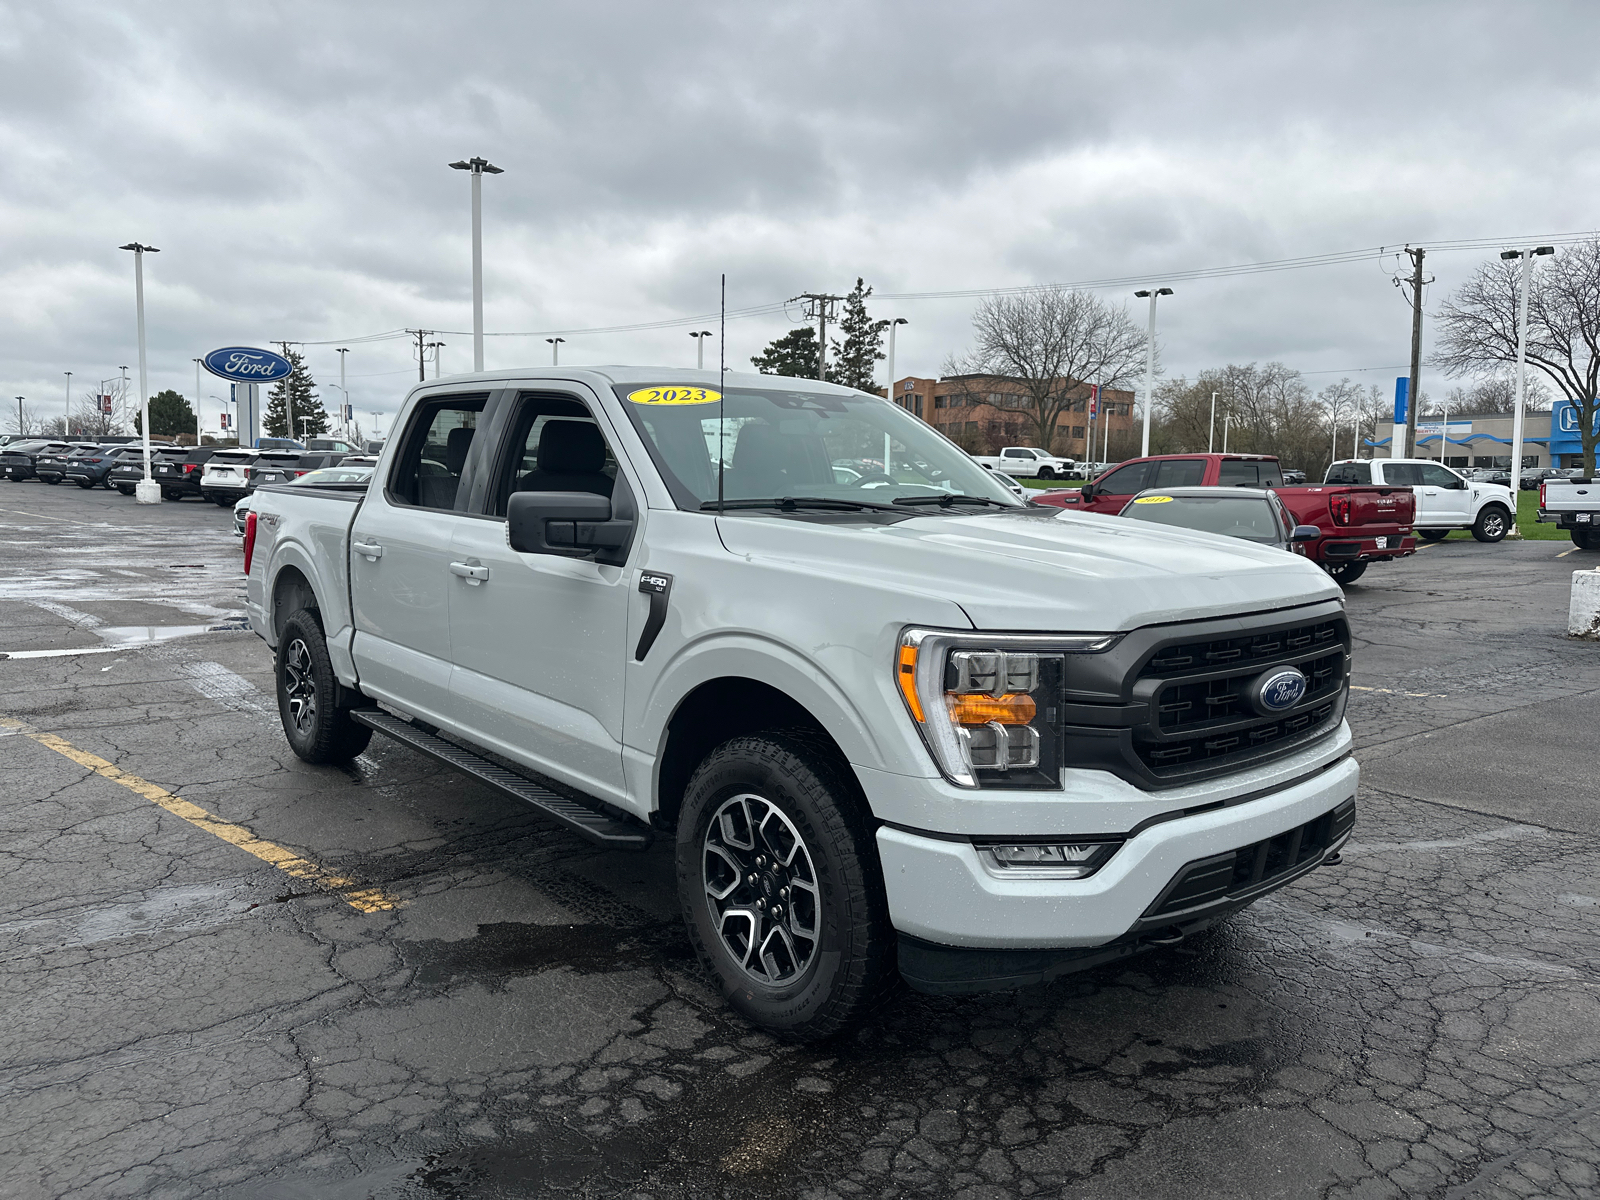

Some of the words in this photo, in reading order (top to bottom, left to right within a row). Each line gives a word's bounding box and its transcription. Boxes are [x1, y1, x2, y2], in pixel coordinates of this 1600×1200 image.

[225, 353, 276, 376] Ford
[647, 389, 707, 402] 2023
[640, 575, 667, 587] F-150
[1273, 680, 1299, 703] Ford
[774, 783, 839, 938] GOODYEAR
